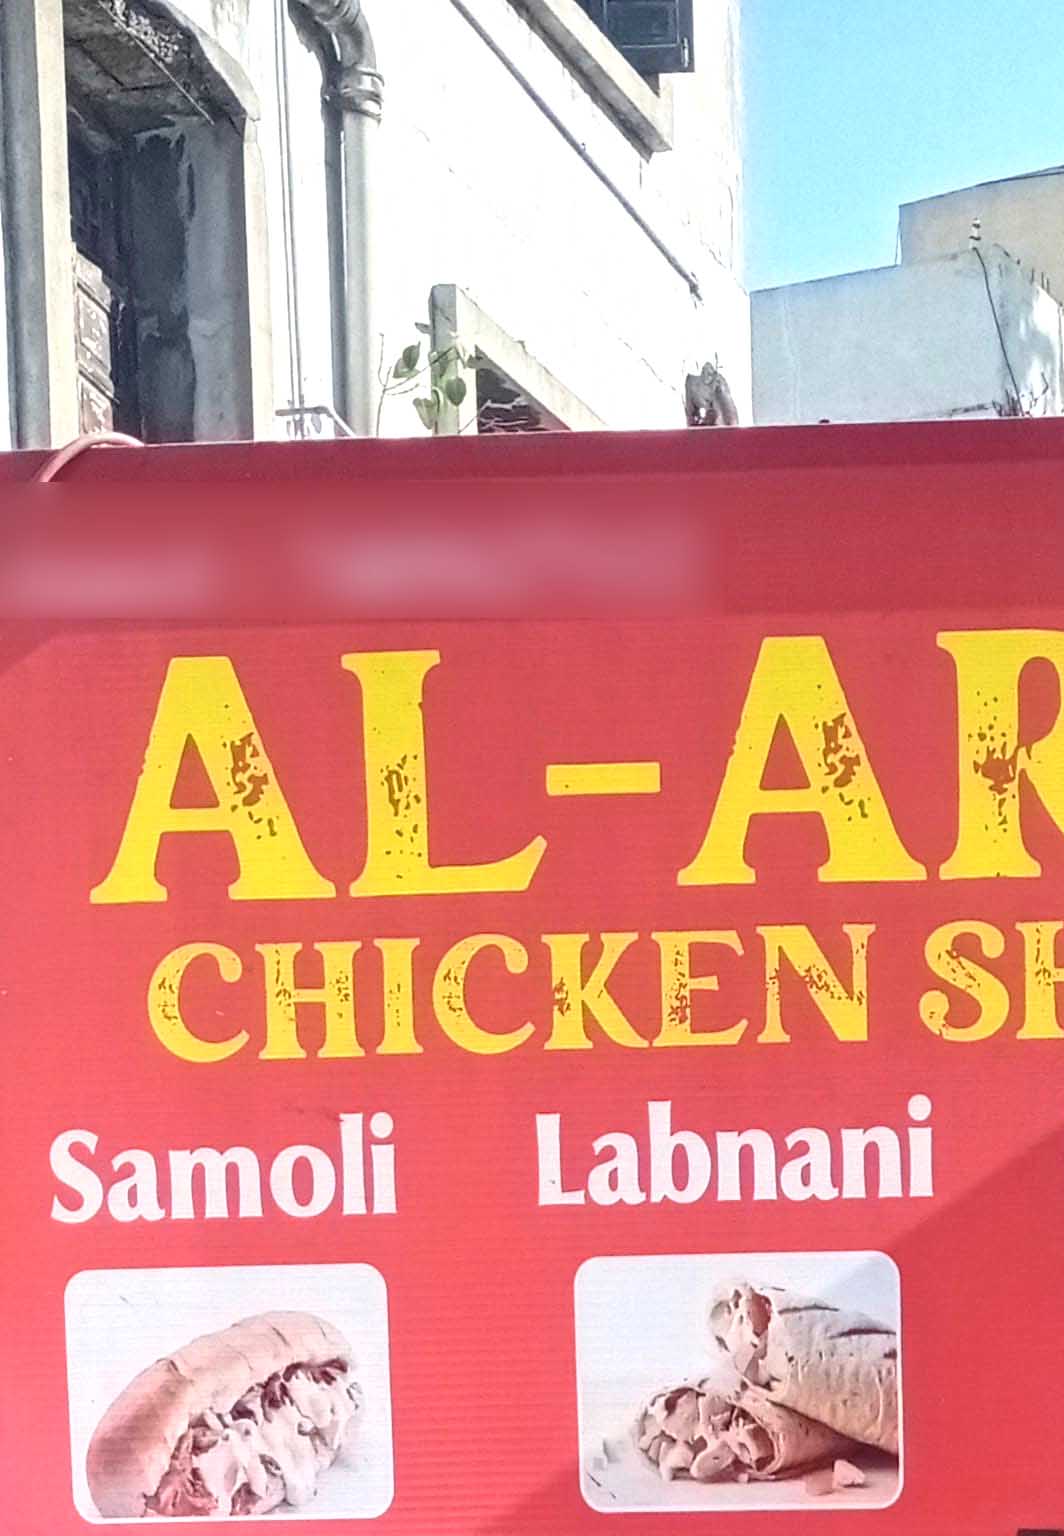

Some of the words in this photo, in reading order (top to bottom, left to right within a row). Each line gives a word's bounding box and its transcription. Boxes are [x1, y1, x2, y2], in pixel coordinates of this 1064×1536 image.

[147, 923, 877, 1064] CHICKEN
[49, 1111, 398, 1225] Samoli
[535, 1094, 935, 1206] Labnani
